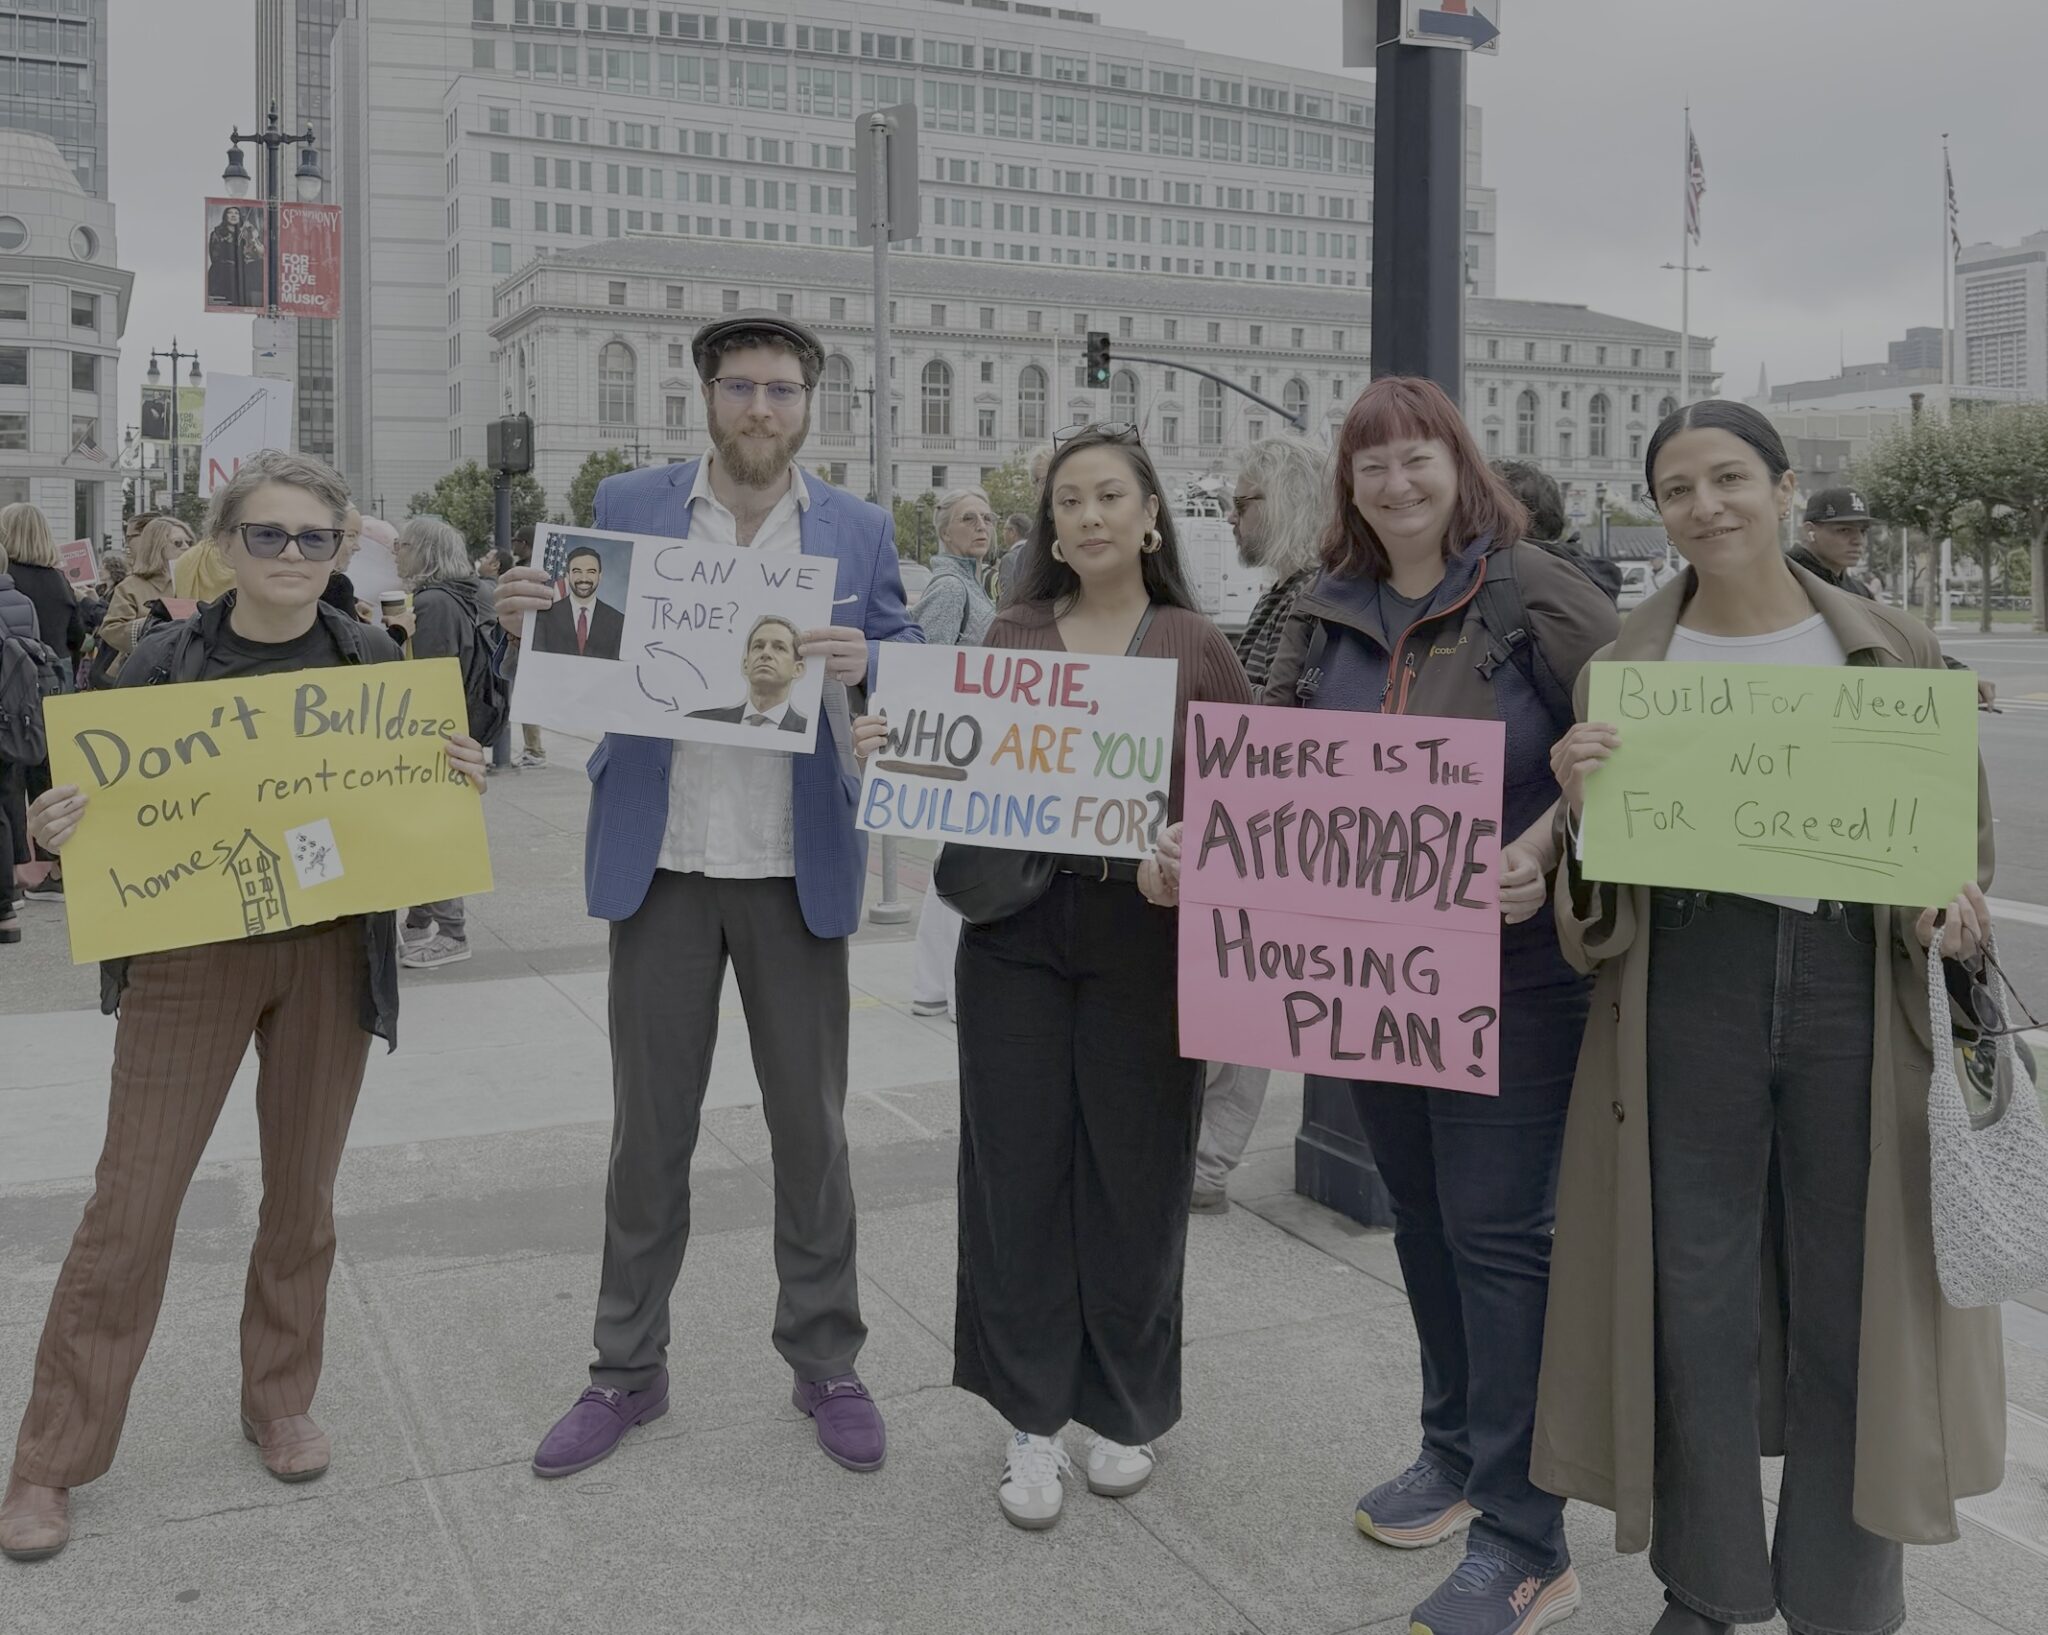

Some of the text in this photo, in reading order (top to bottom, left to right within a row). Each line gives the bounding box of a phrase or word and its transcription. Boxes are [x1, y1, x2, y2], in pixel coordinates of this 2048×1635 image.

[282, 253, 309, 265] FOR
[282, 263, 309, 275] THE
[282, 273, 316, 285] LOVE
[282, 283, 300, 293] OF
[282, 293, 324, 305] MUSIC
[654, 546, 821, 590] CAN WE
[641, 595, 740, 634] TRADE?
[954, 651, 1099, 715] LURIE,
[1833, 678, 1941, 729] Need
[73, 682, 457, 789] Don't Bulldoze
[879, 707, 1163, 783] WHO ARE YOU
[1194, 713, 1486, 785] WHERE IS THE
[137, 791, 211, 827] our
[863, 777, 1168, 854] BUILDING FOR?
[110, 838, 233, 907] homes
[1197, 800, 1498, 911] AFFORDABLE
[1212, 909, 1440, 995] HOUSING
[1508, 1576, 1542, 1617] HOK
